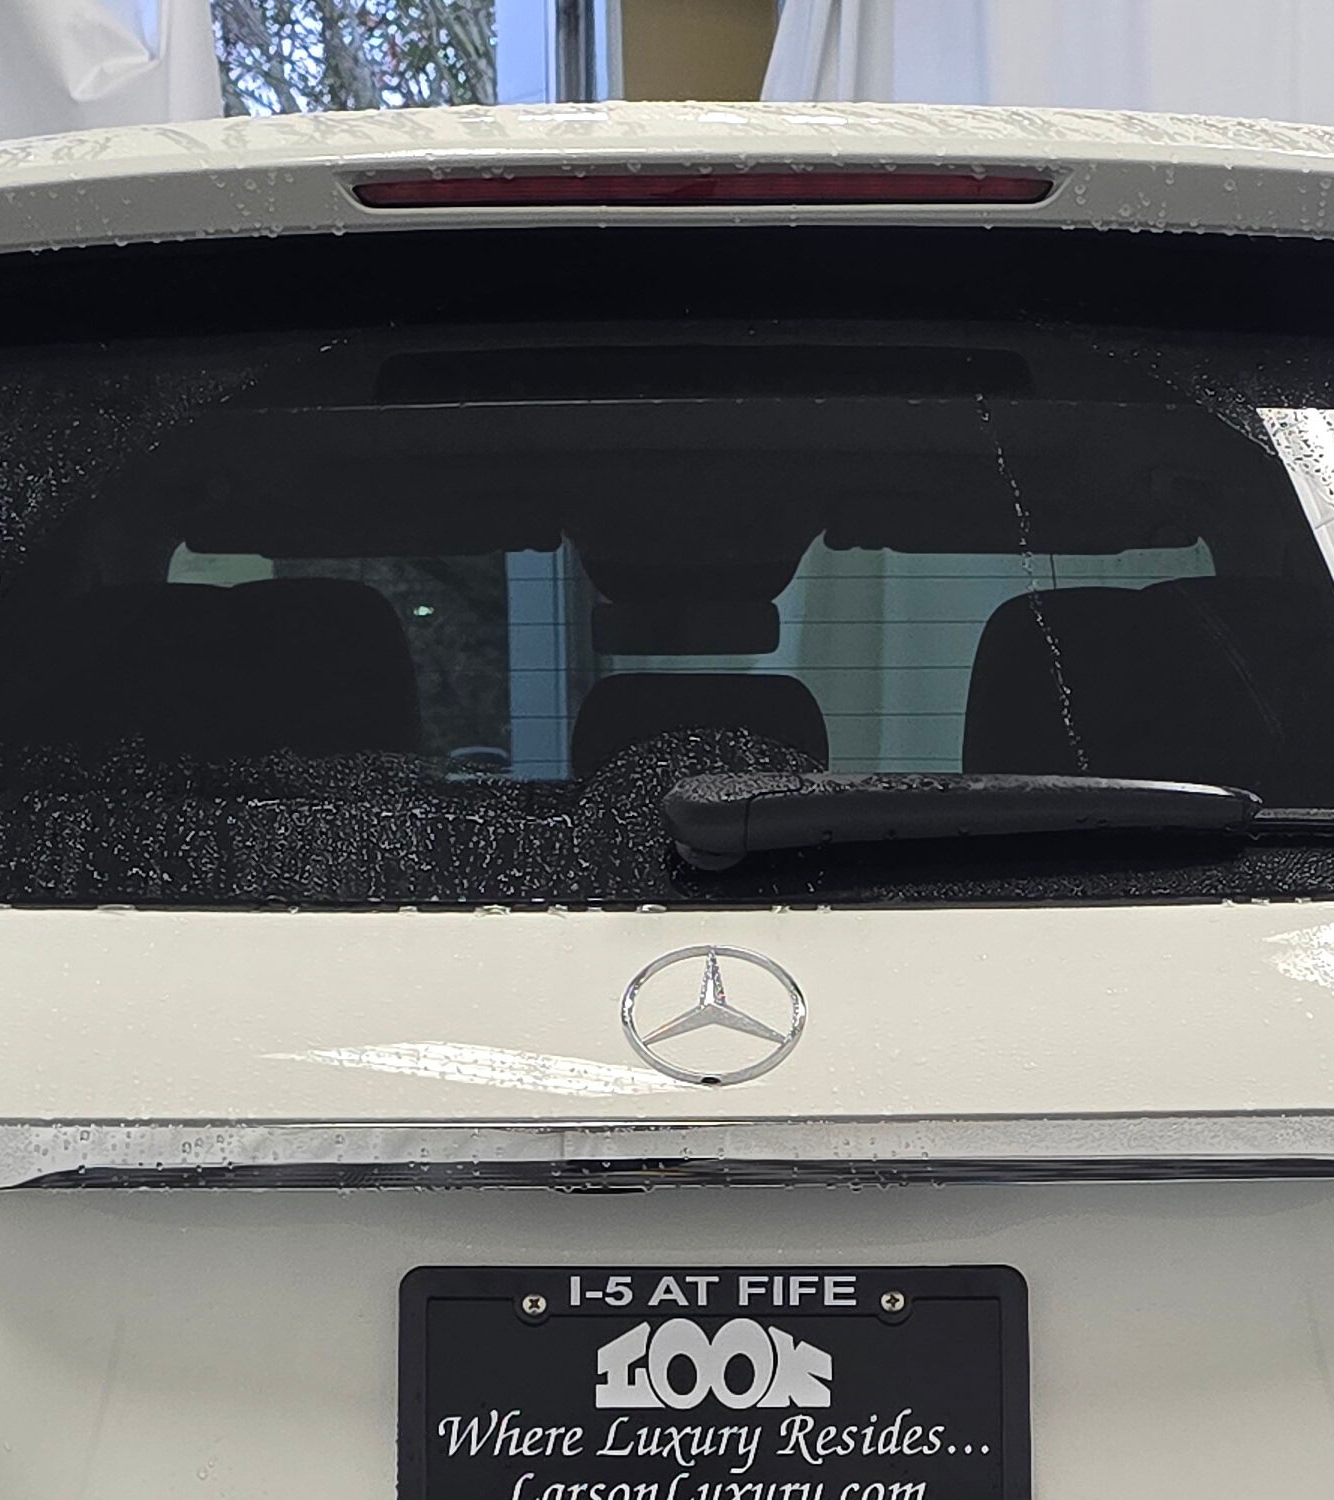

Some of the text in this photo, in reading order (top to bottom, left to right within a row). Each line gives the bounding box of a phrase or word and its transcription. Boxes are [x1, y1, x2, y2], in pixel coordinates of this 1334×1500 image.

[569, 1276, 858, 1307] I-5 AT FIFE
[595, 1317, 833, 1410] LOOK
[437, 1408, 992, 1473] Where Luxury Resides...
